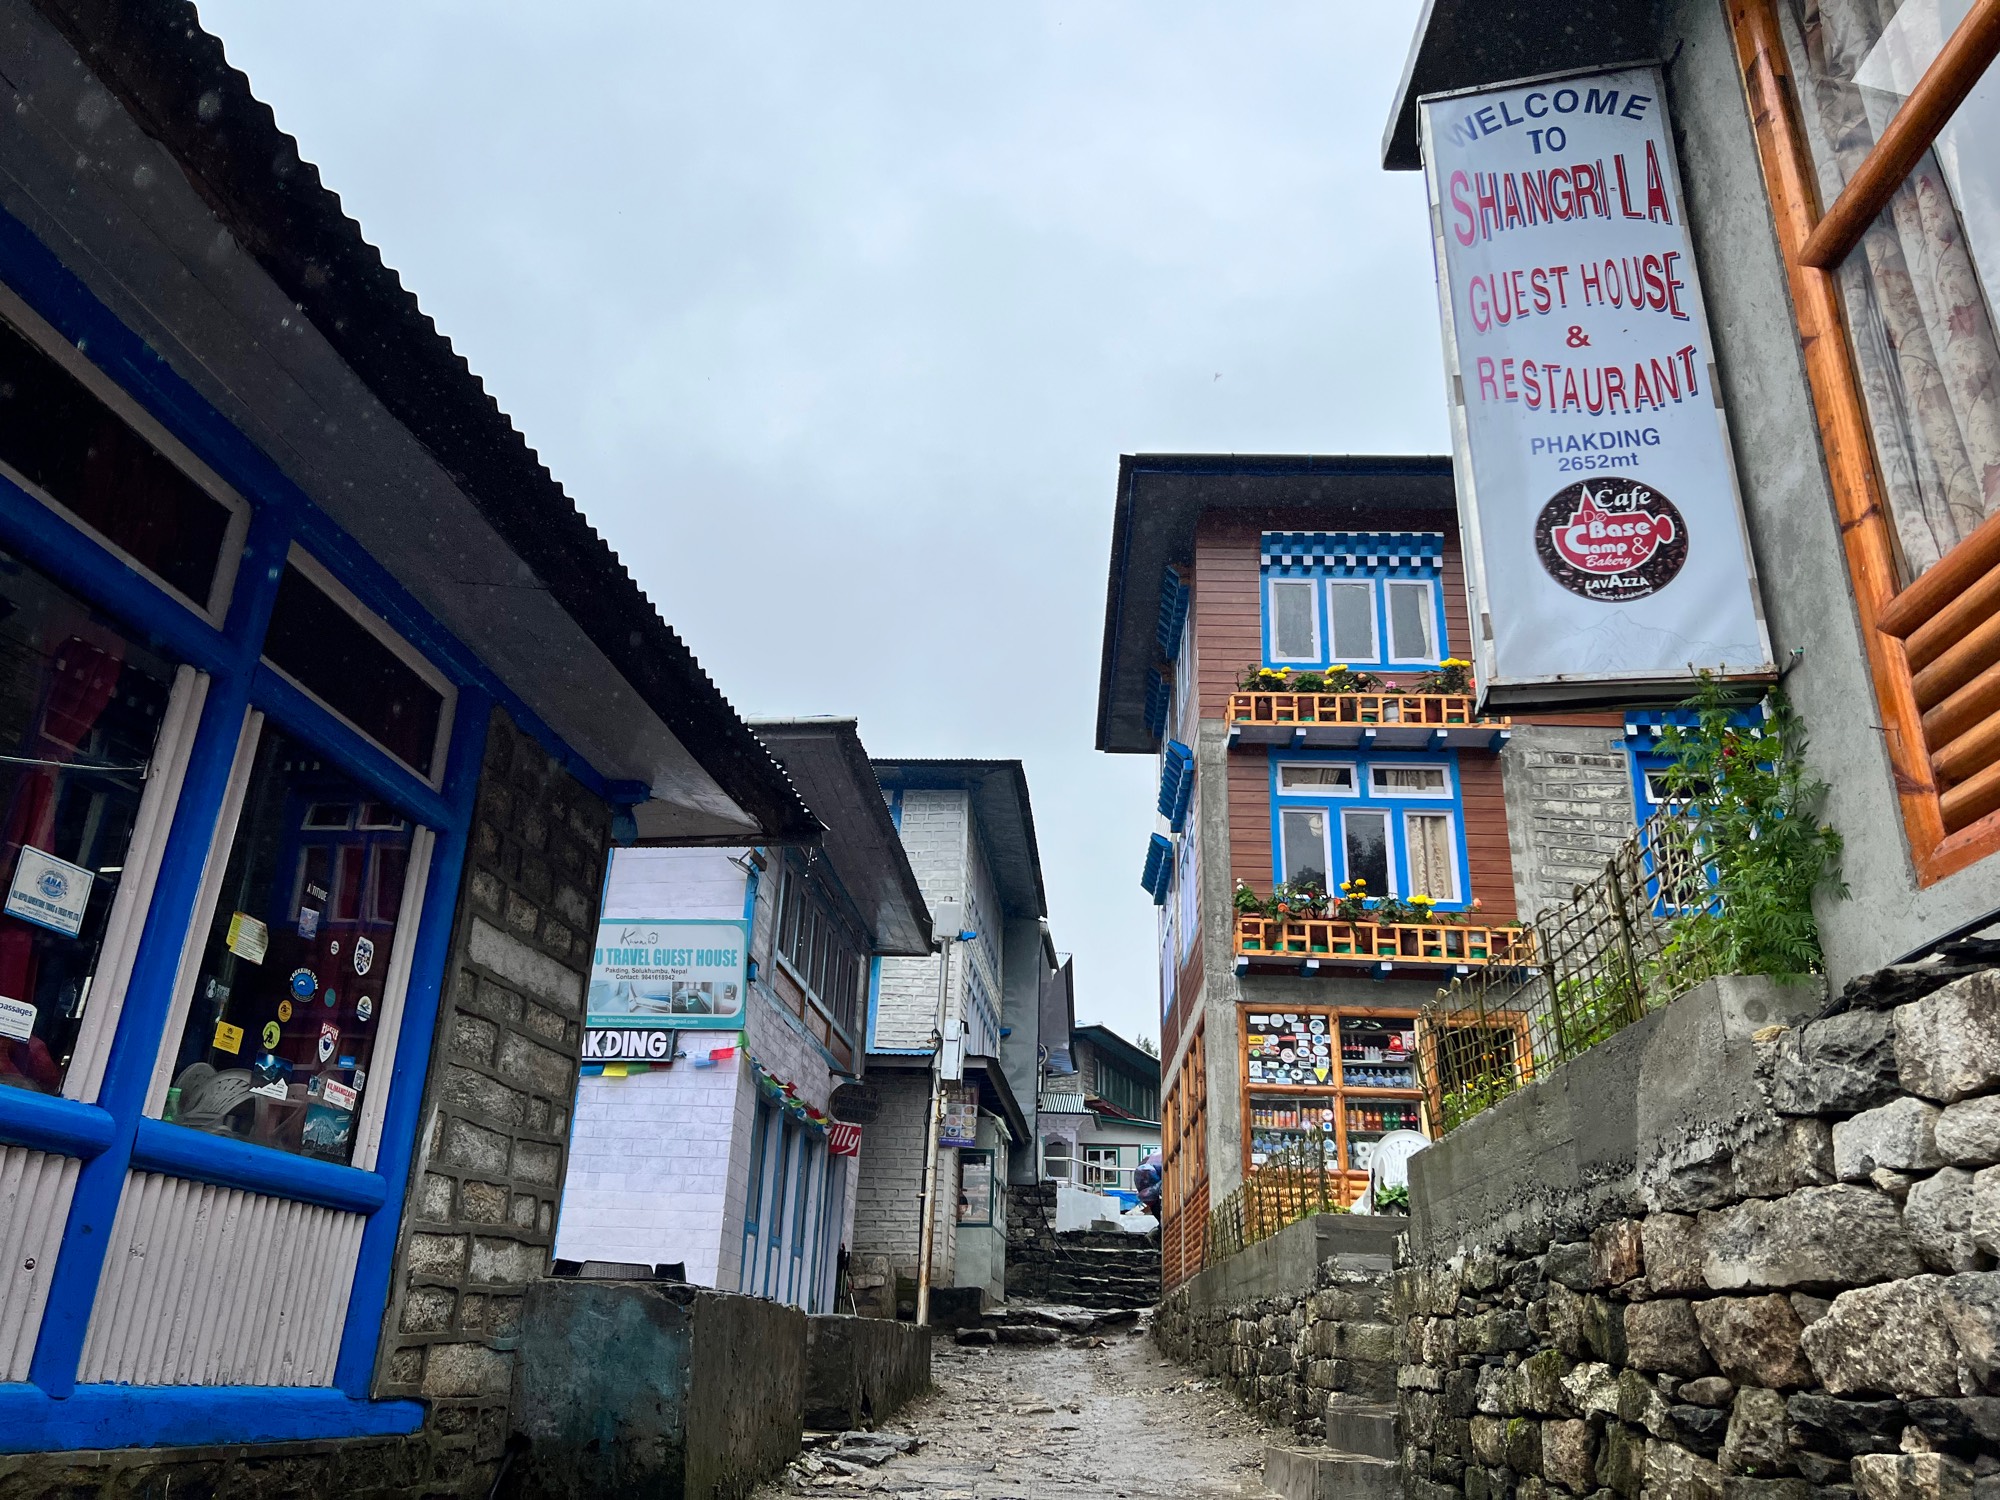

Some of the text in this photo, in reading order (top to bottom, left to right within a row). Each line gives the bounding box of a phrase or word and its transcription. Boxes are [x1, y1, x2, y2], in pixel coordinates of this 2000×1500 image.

[1446, 88, 1652, 148] WELCOME
[1526, 126, 1566, 154] TO
[1450, 138, 1673, 247] SHANGRI-LA
[1469, 251, 1690, 333] GUEST HOUSE
[1566, 325, 1592, 349] &
[1476, 344, 1697, 416] RESTAURANT
[1530, 427, 1661, 455] PHAKDING
[1558, 452, 1640, 472] 2652mt
[1594, 486, 1652, 511] Cafe
[1583, 510, 1607, 523] De
[1564, 524, 1650, 555] Camp &
[1588, 521, 1651, 539] Base
[1585, 554, 1632, 568] Bakery
[307, 883, 328, 902] ATITUDE
[606, 948, 650, 966] TRAVEL
[653, 948, 694, 966] GUEST
[695, 949, 737, 967] HOUSE
[831, 1125, 860, 1154] illy
